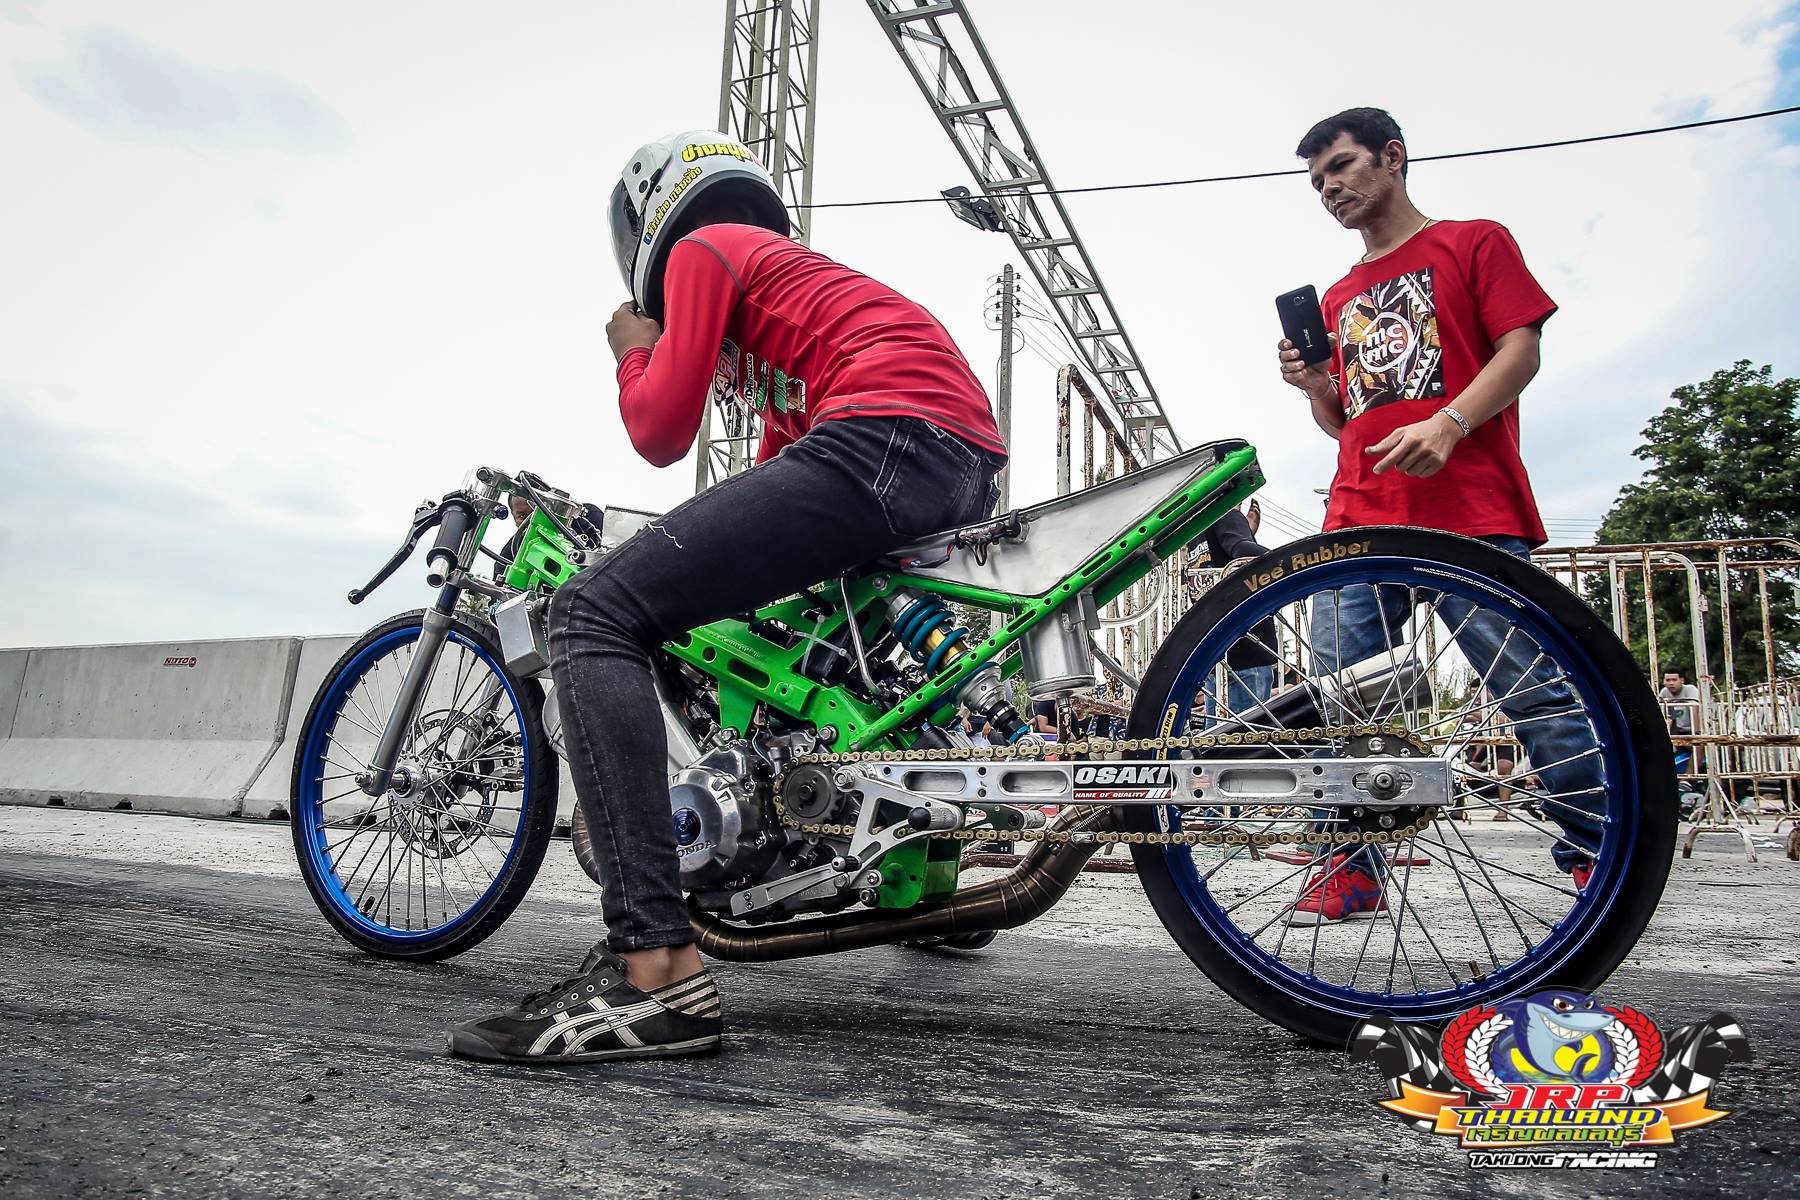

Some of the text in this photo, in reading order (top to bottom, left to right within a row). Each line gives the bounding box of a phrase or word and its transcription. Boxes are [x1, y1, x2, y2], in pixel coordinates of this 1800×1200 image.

[1243, 566, 1284, 592] Vee
[1291, 540, 1371, 571] Rubber
[1075, 766, 1170, 784] OSAKI
[676, 840, 716, 857] ONDA
